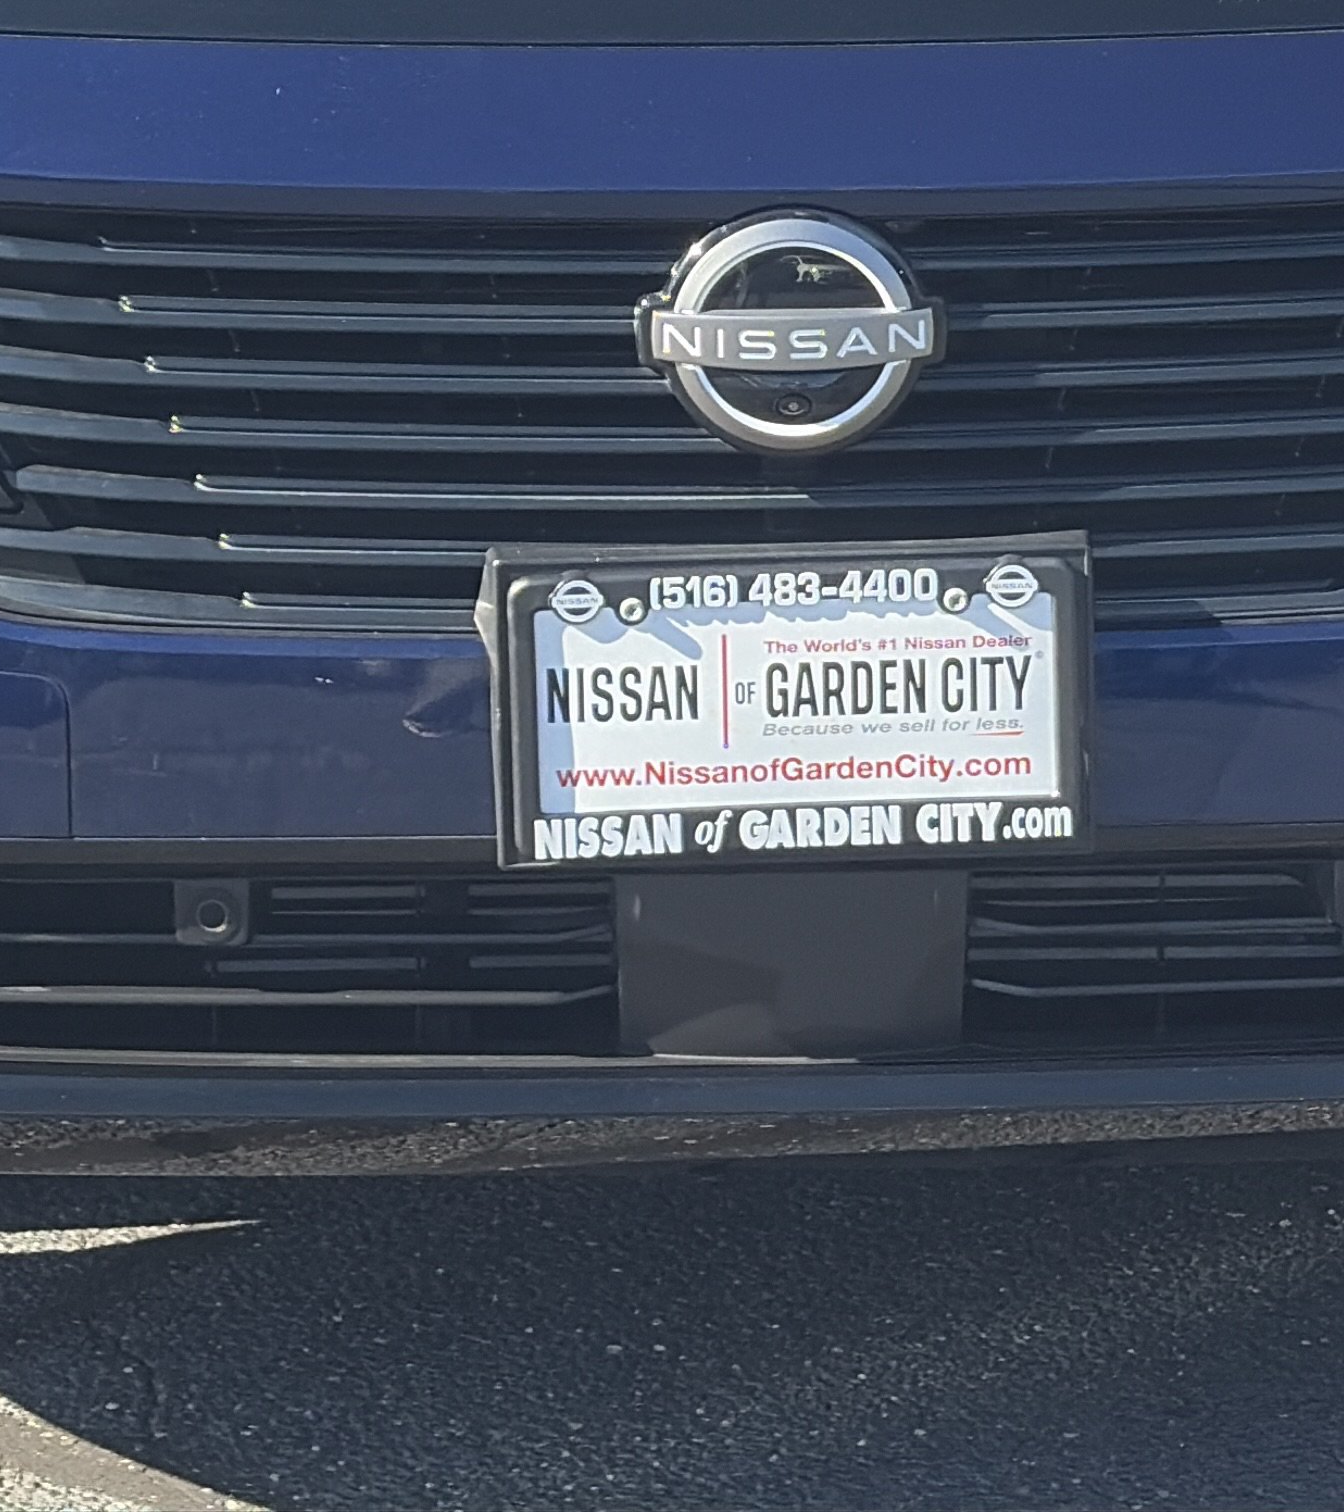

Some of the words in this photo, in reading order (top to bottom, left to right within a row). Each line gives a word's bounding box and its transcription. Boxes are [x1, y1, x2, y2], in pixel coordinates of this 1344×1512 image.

[662, 319, 926, 360] NISSAN
[649, 574, 739, 611] (516)
[749, 567, 939, 608] 483-4400
[763, 640, 798, 654] The
[804, 637, 872, 653] World's
[878, 638, 898, 651] #1
[905, 636, 967, 650] Nissan
[972, 634, 1033, 649] Dealer
[546, 664, 699, 724] NISSAN
[734, 682, 757, 705] OF
[765, 657, 927, 719] GARDEN
[941, 654, 1033, 714] CITY
[762, 722, 854, 737] Because
[861, 722, 892, 734] we
[899, 718, 936, 732] sell
[942, 718, 970, 732] for
[975, 717, 1025, 731] less.
[556, 753, 1032, 788] www.NissanofGardenCity.com
[533, 812, 685, 861] NISSAN
[694, 809, 734, 854] of
[739, 804, 904, 850] GARDEN
[915, 801, 1074, 845] CITY.com
